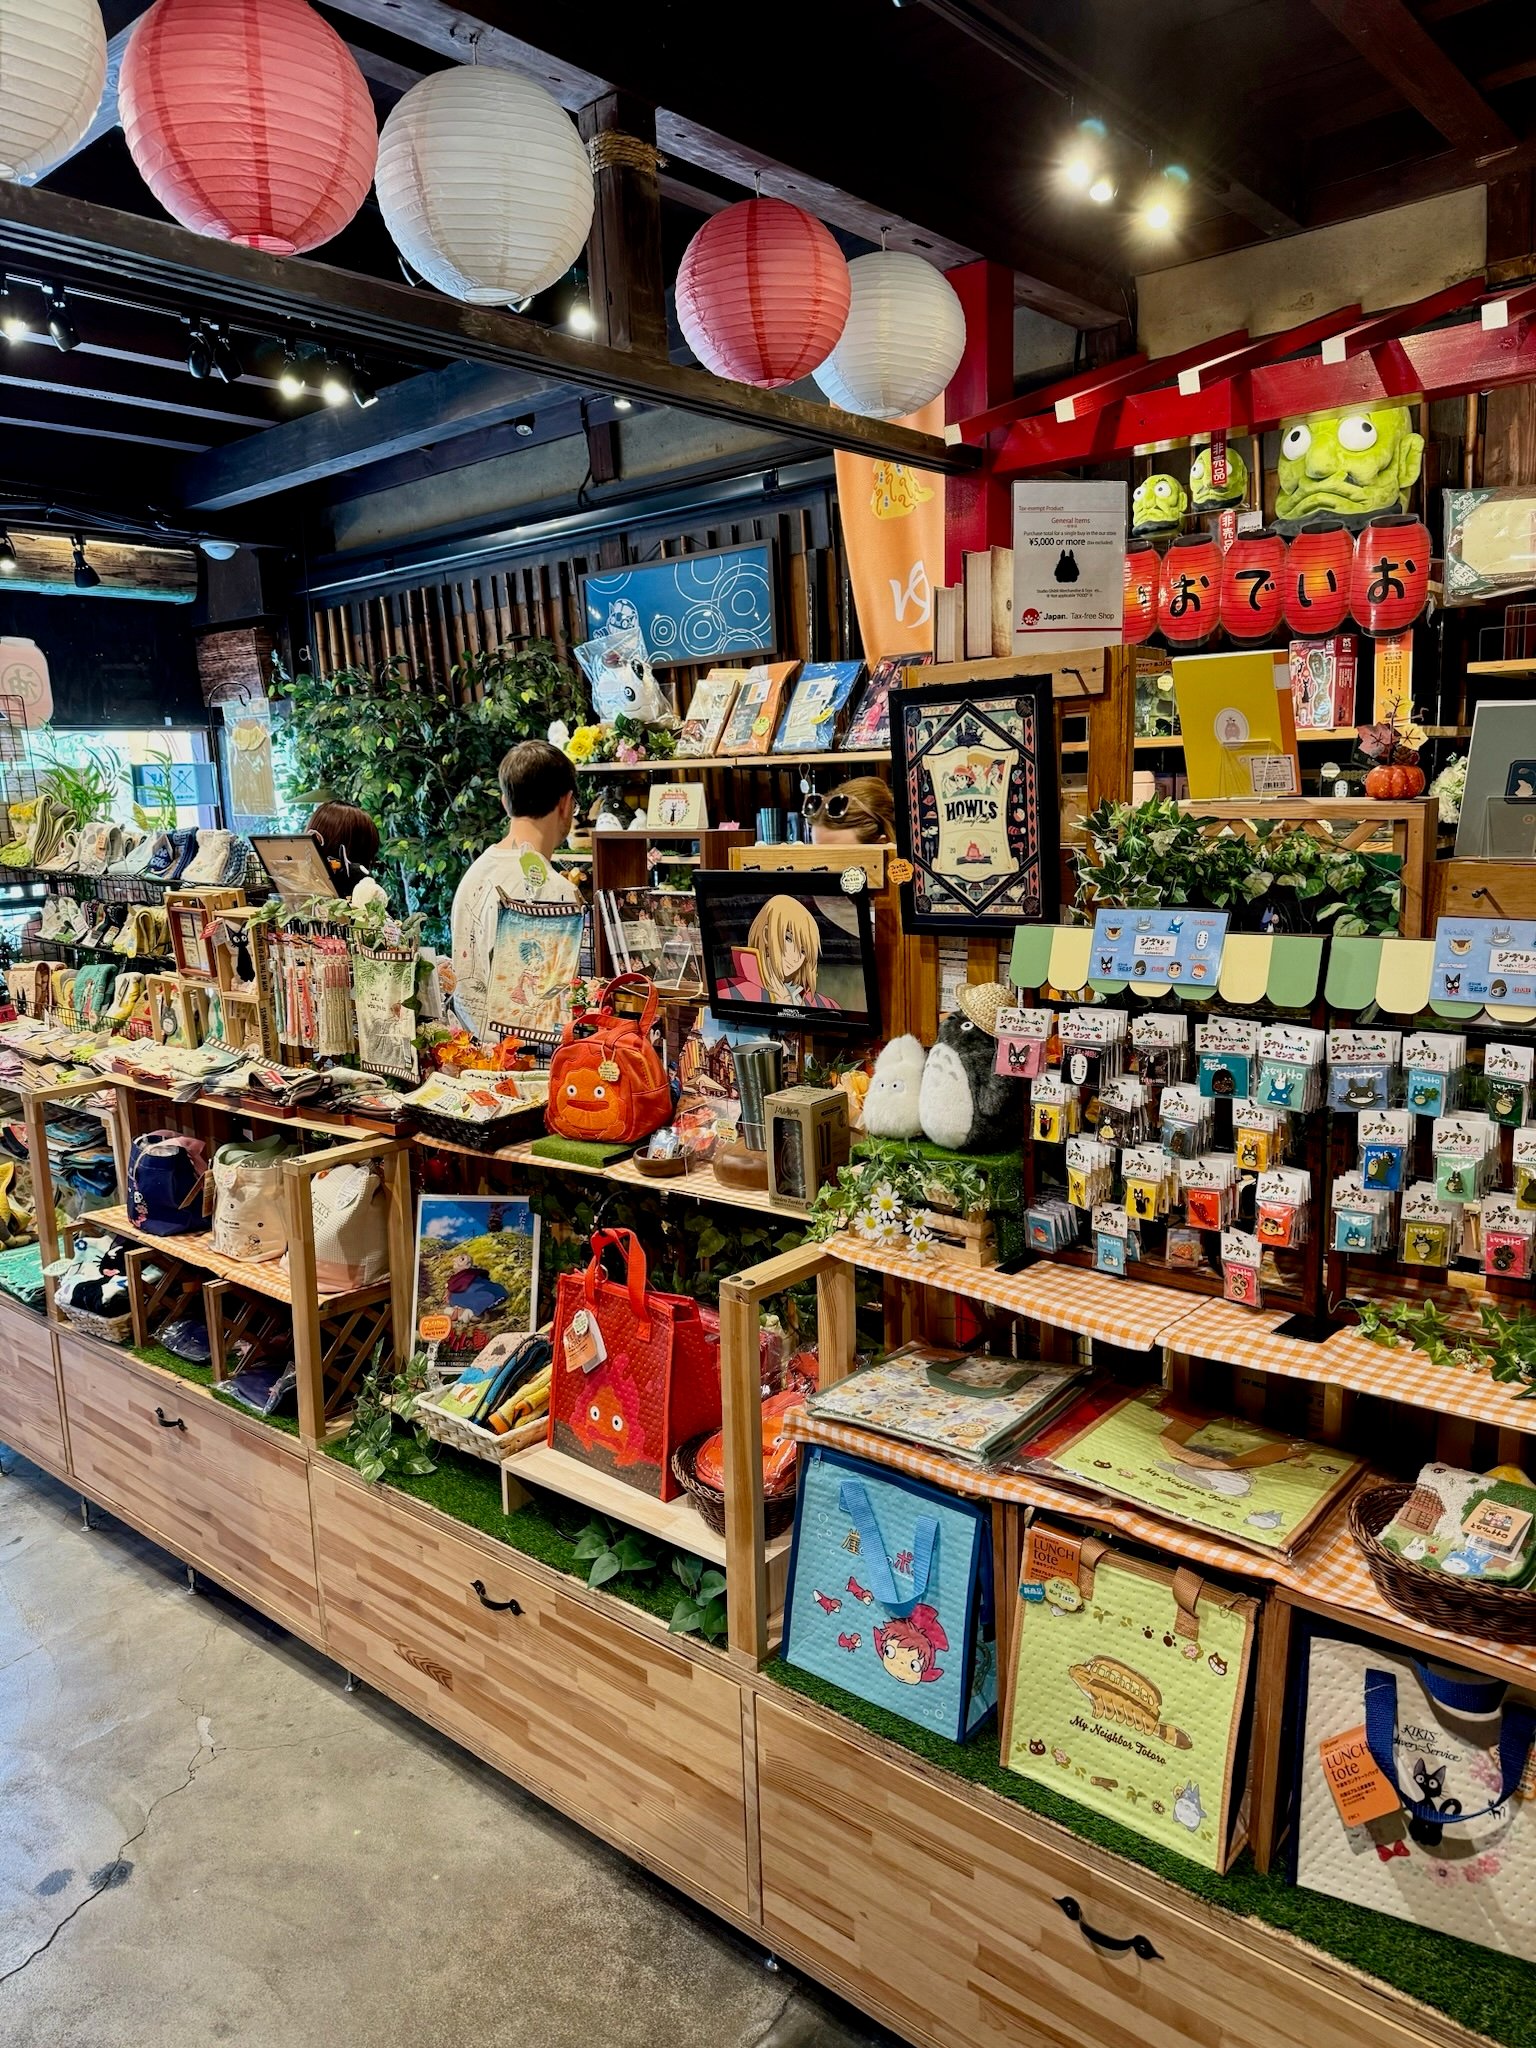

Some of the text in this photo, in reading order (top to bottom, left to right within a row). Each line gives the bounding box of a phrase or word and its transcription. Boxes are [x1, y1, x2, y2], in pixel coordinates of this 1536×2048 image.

[1212, 442, 1227, 482] 非売品
[1029, 537, 1054, 546] ¥5,000
[1056, 538, 1064, 546] or
[1066, 538, 1086, 546] more
[889, 560, 931, 629] ゆ
[1169, 573, 1210, 617] お
[1234, 569, 1276, 611] で
[1298, 568, 1337, 607] い
[1367, 557, 1417, 604] お
[1071, 612, 1097, 620] Tax-free
[1098, 612, 1115, 621] Shop
[944, 799, 998, 822] HOWL'S
[260, 1007, 269, 1033] HAPPINESS
[1034, 1538, 1074, 1561] LUNCH
[1034, 1549, 1058, 1566] tote
[1070, 1715, 1167, 1766] My Neighbor Totoro
[1326, 1741, 1372, 1770] LUNCH
[1332, 1762, 1360, 1782] tote
